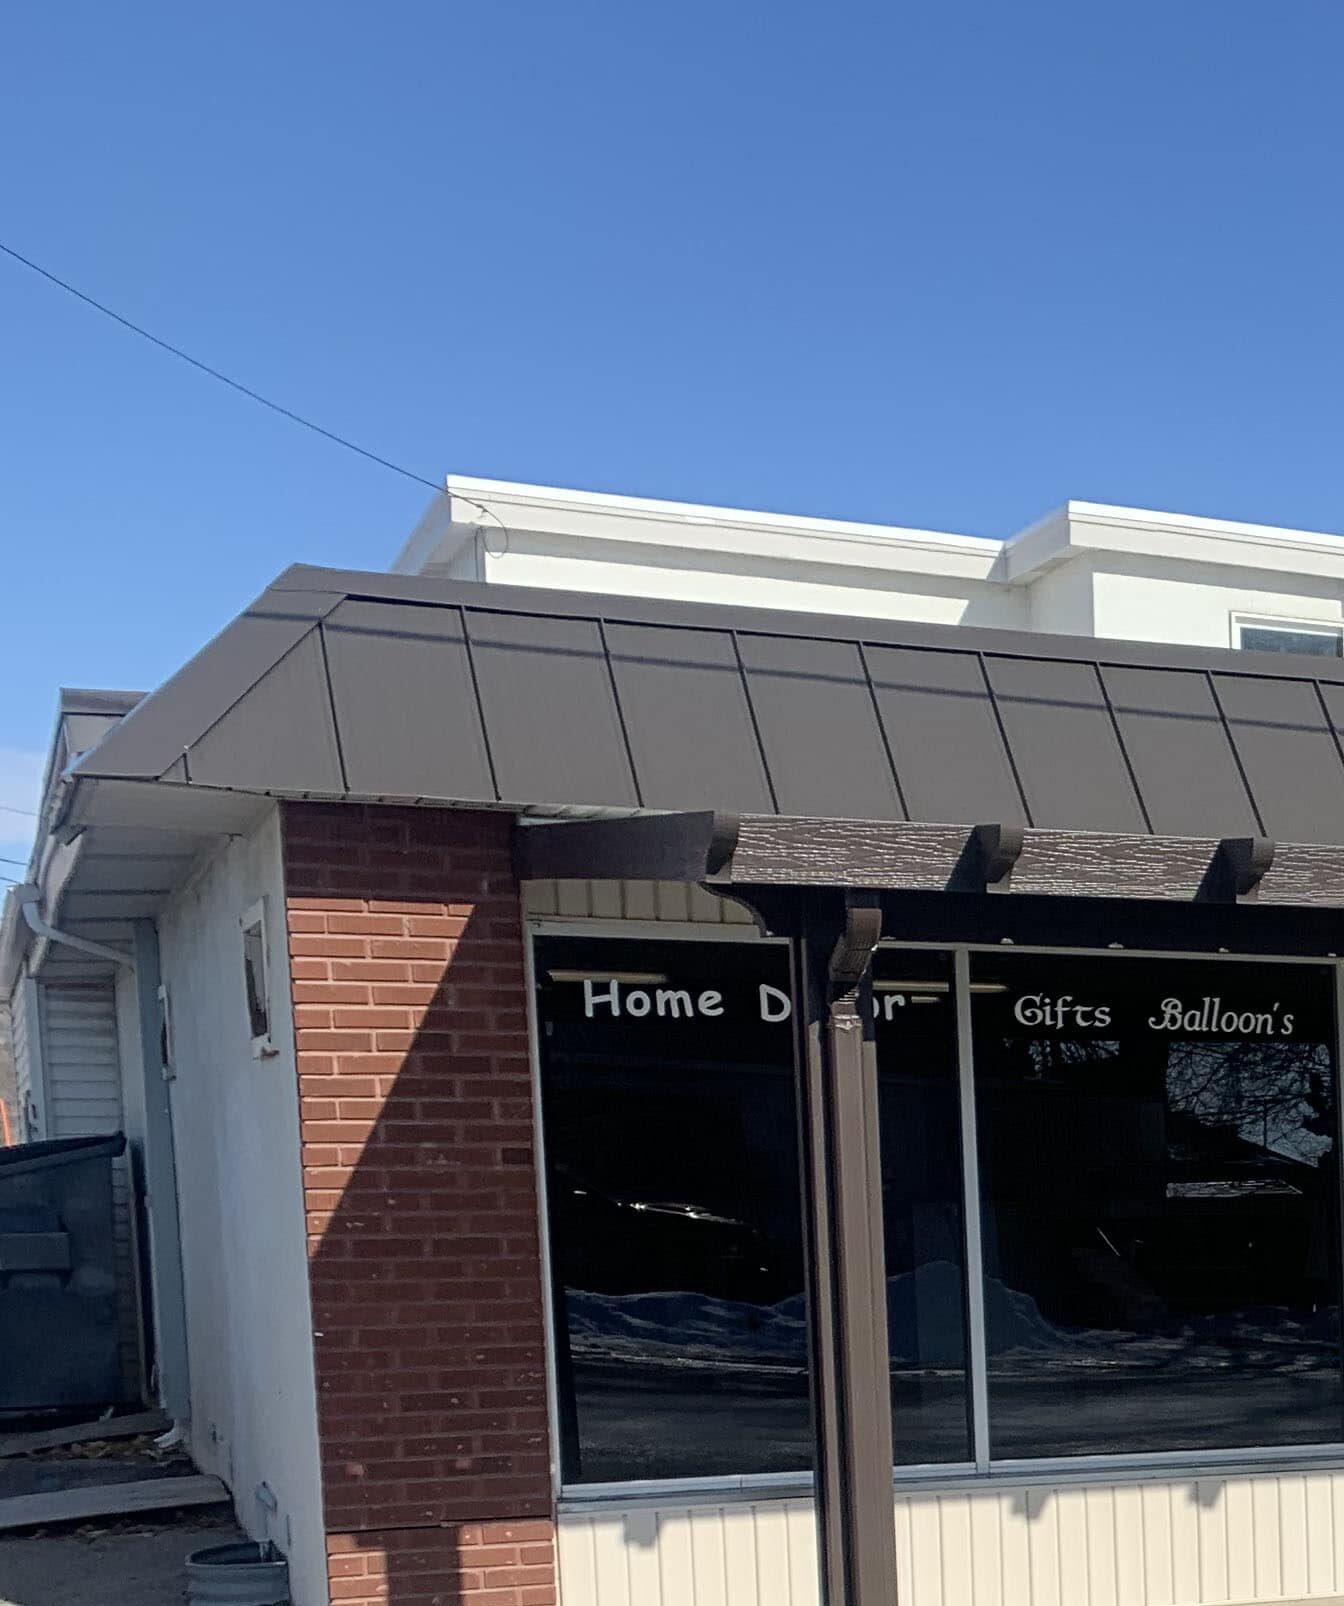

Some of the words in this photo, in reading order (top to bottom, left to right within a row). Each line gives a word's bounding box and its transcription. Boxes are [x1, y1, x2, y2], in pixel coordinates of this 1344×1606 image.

[583, 979, 725, 1018] Home
[1013, 993, 1112, 1029] Gifts
[1148, 997, 1295, 1035] Balloon's
